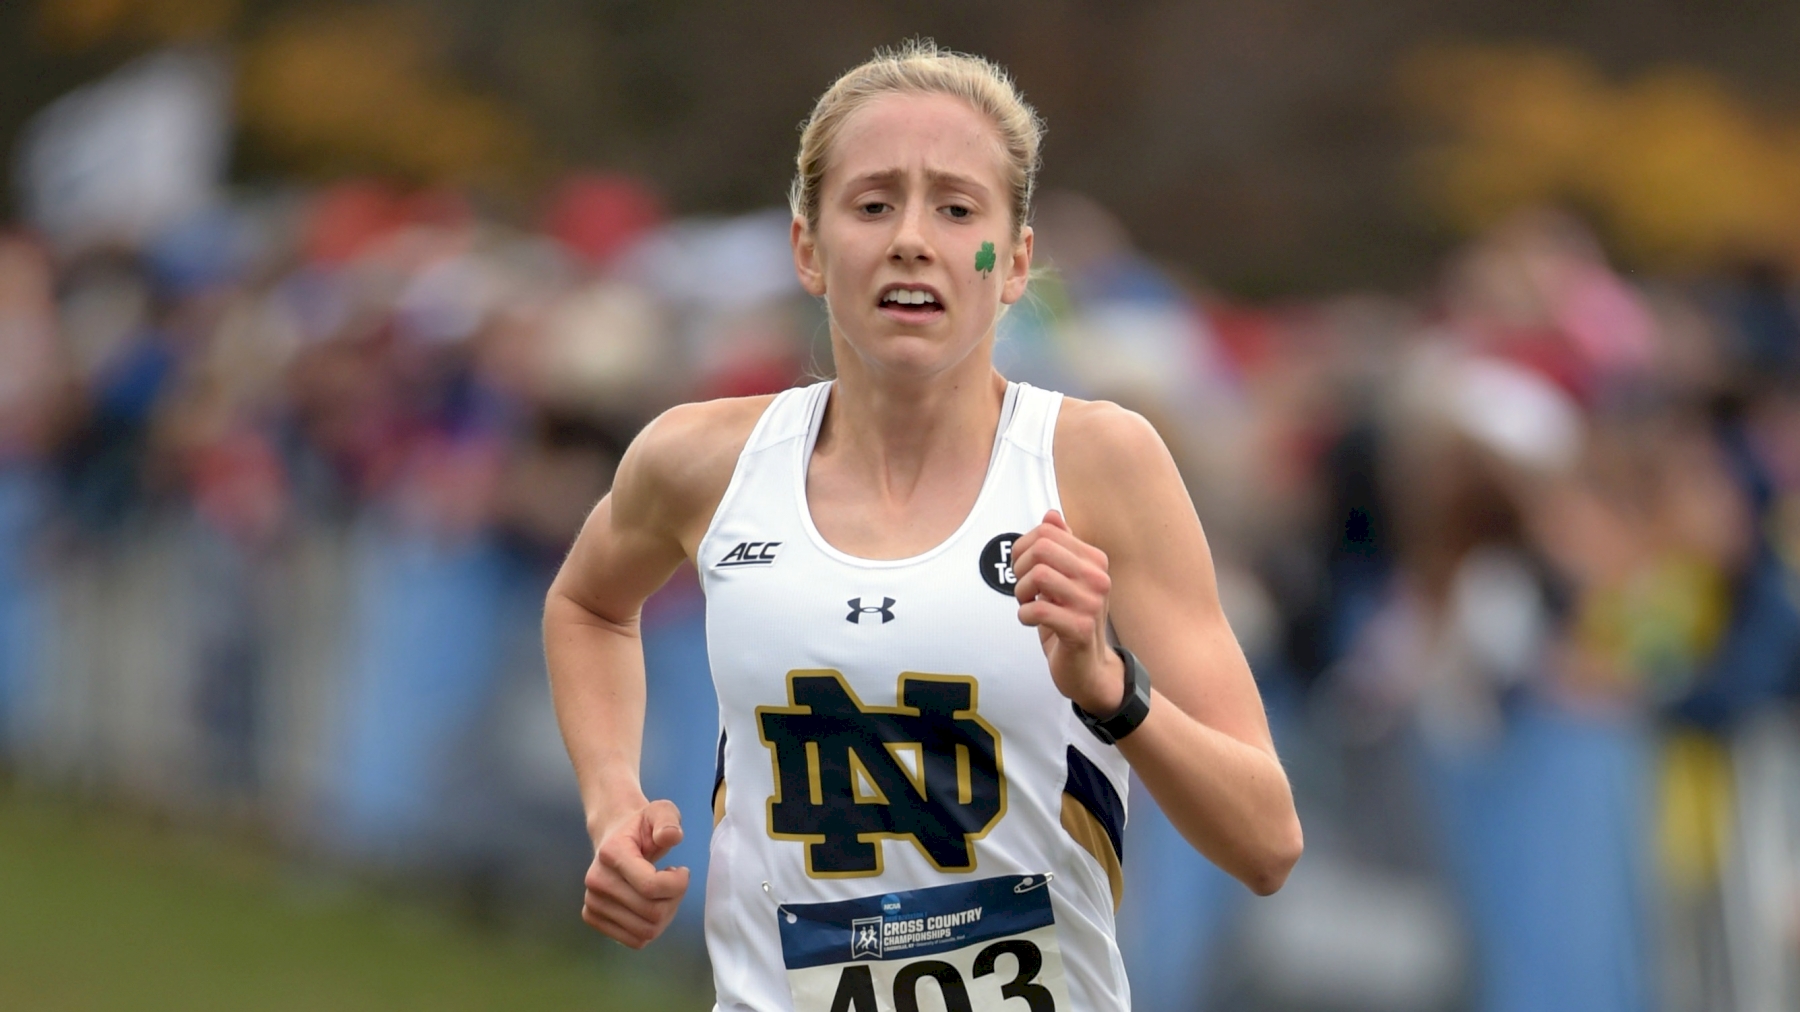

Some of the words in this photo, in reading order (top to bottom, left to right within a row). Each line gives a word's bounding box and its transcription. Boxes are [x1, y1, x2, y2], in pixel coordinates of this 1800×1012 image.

[720, 542, 783, 562] ACC
[1000, 540, 1012, 562] F
[994, 563, 1017, 584] Te
[884, 918, 924, 937] CROSS
[926, 906, 983, 930] COUNTRY
[884, 928, 952, 947] CHAMPIONSHIPS
